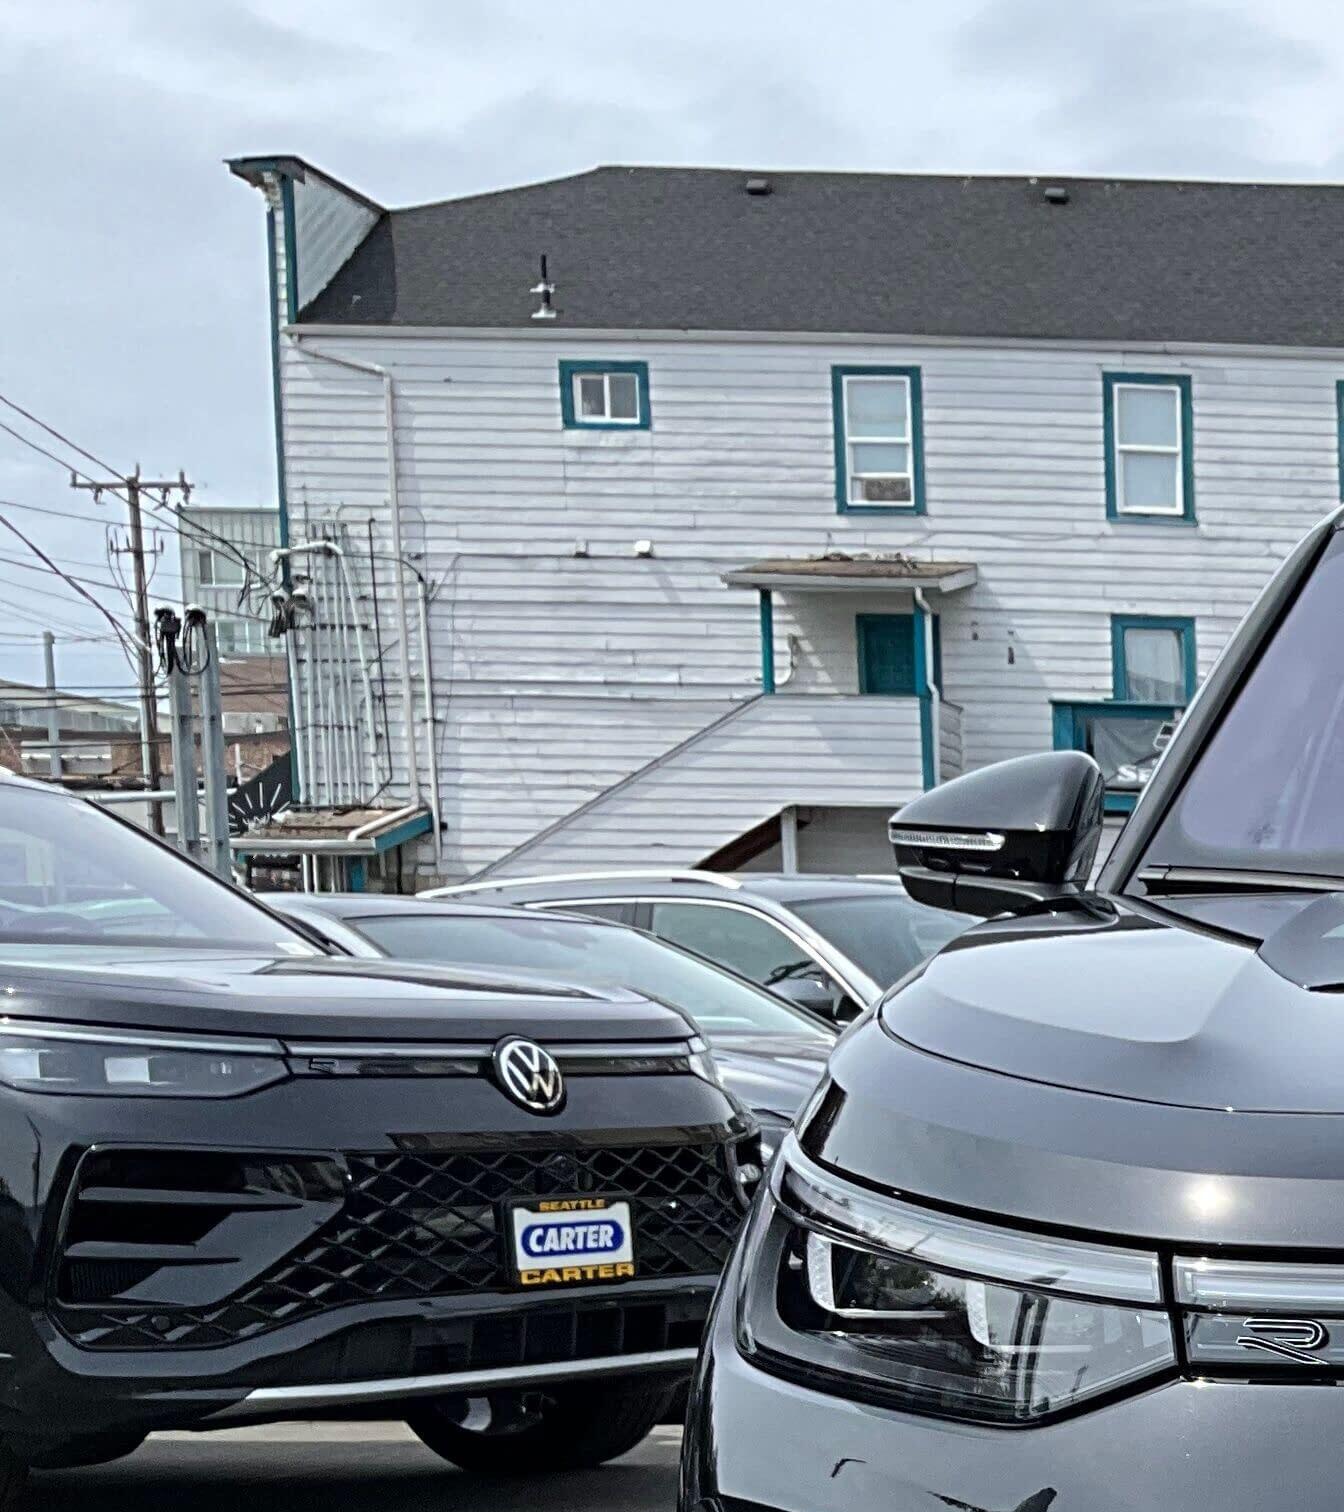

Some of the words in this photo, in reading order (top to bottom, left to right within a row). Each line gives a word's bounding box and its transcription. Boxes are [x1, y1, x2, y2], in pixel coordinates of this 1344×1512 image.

[539, 1199, 605, 1211] SEATTLE
[529, 1223, 615, 1253] CARTER
[520, 1262, 635, 1285] CARTER
